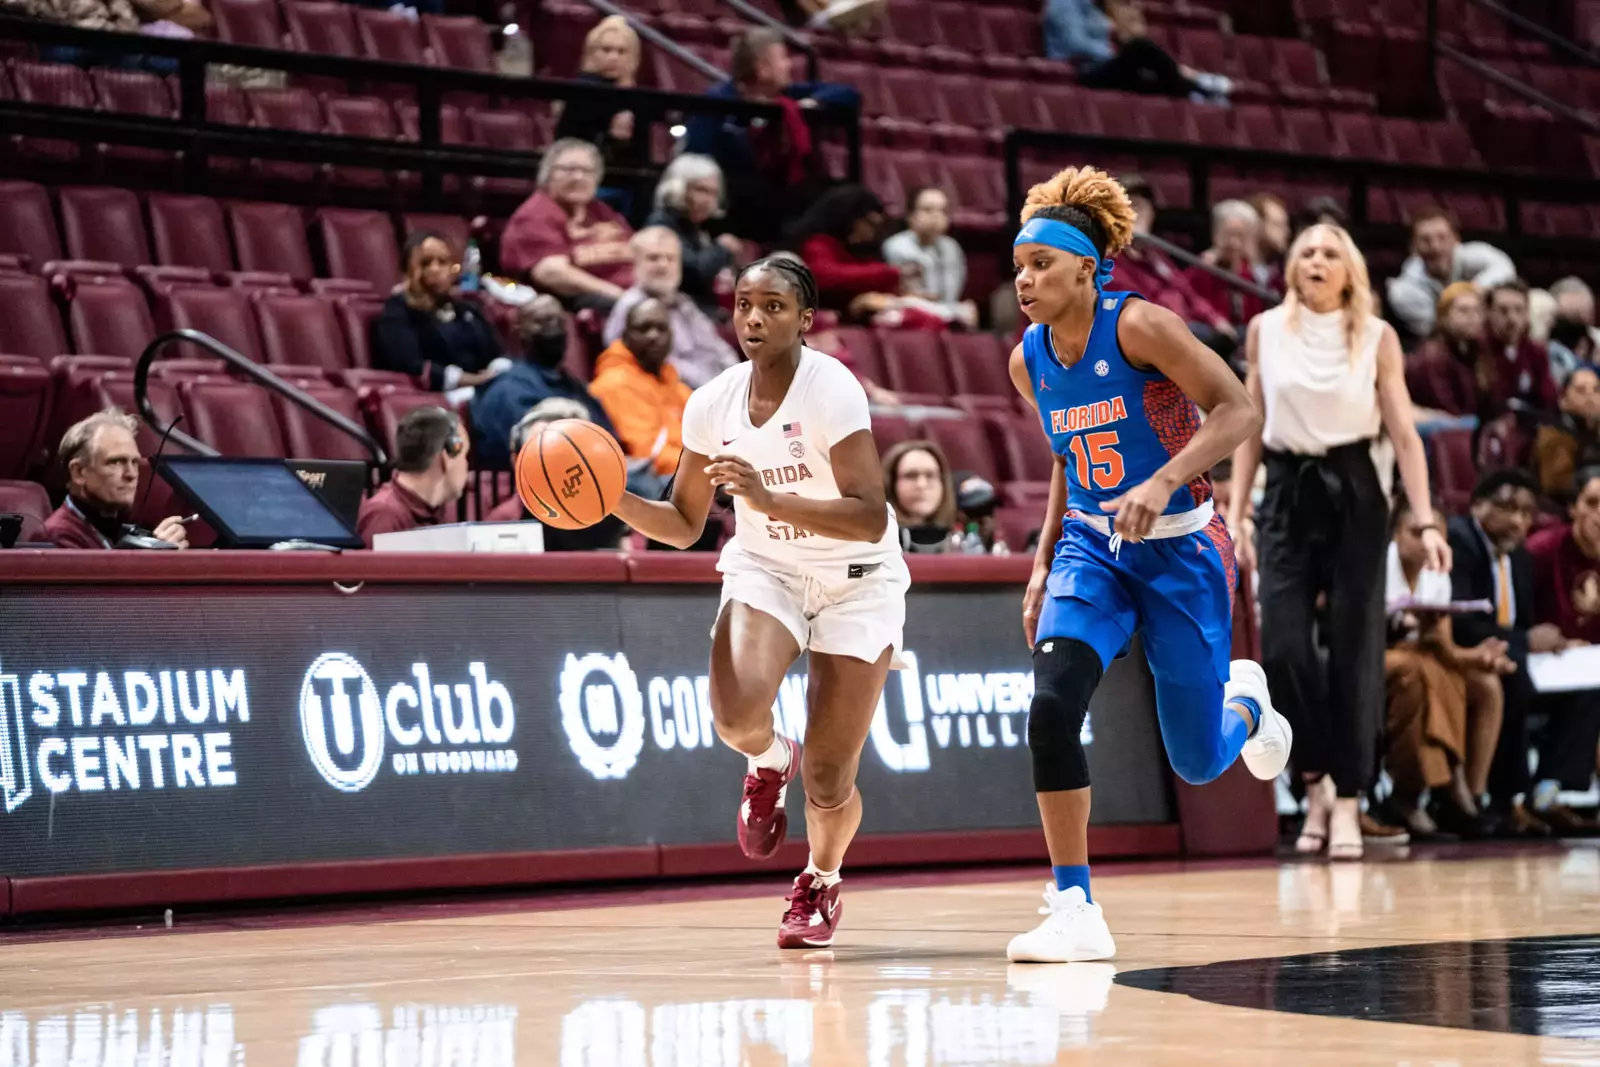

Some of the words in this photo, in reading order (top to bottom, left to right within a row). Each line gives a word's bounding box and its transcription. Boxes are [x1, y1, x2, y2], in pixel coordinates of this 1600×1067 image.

[1050, 395, 1128, 434] FLORIDA
[758, 462, 813, 487] RIDA
[1069, 430, 1125, 491] 15
[766, 524, 815, 540] STA
[28, 669, 250, 728] STADIUM
[385, 661, 516, 746] club
[925, 671, 1035, 715] UNIVER
[930, 712, 1094, 748] VILLE
[37, 732, 237, 793] CENTRE
